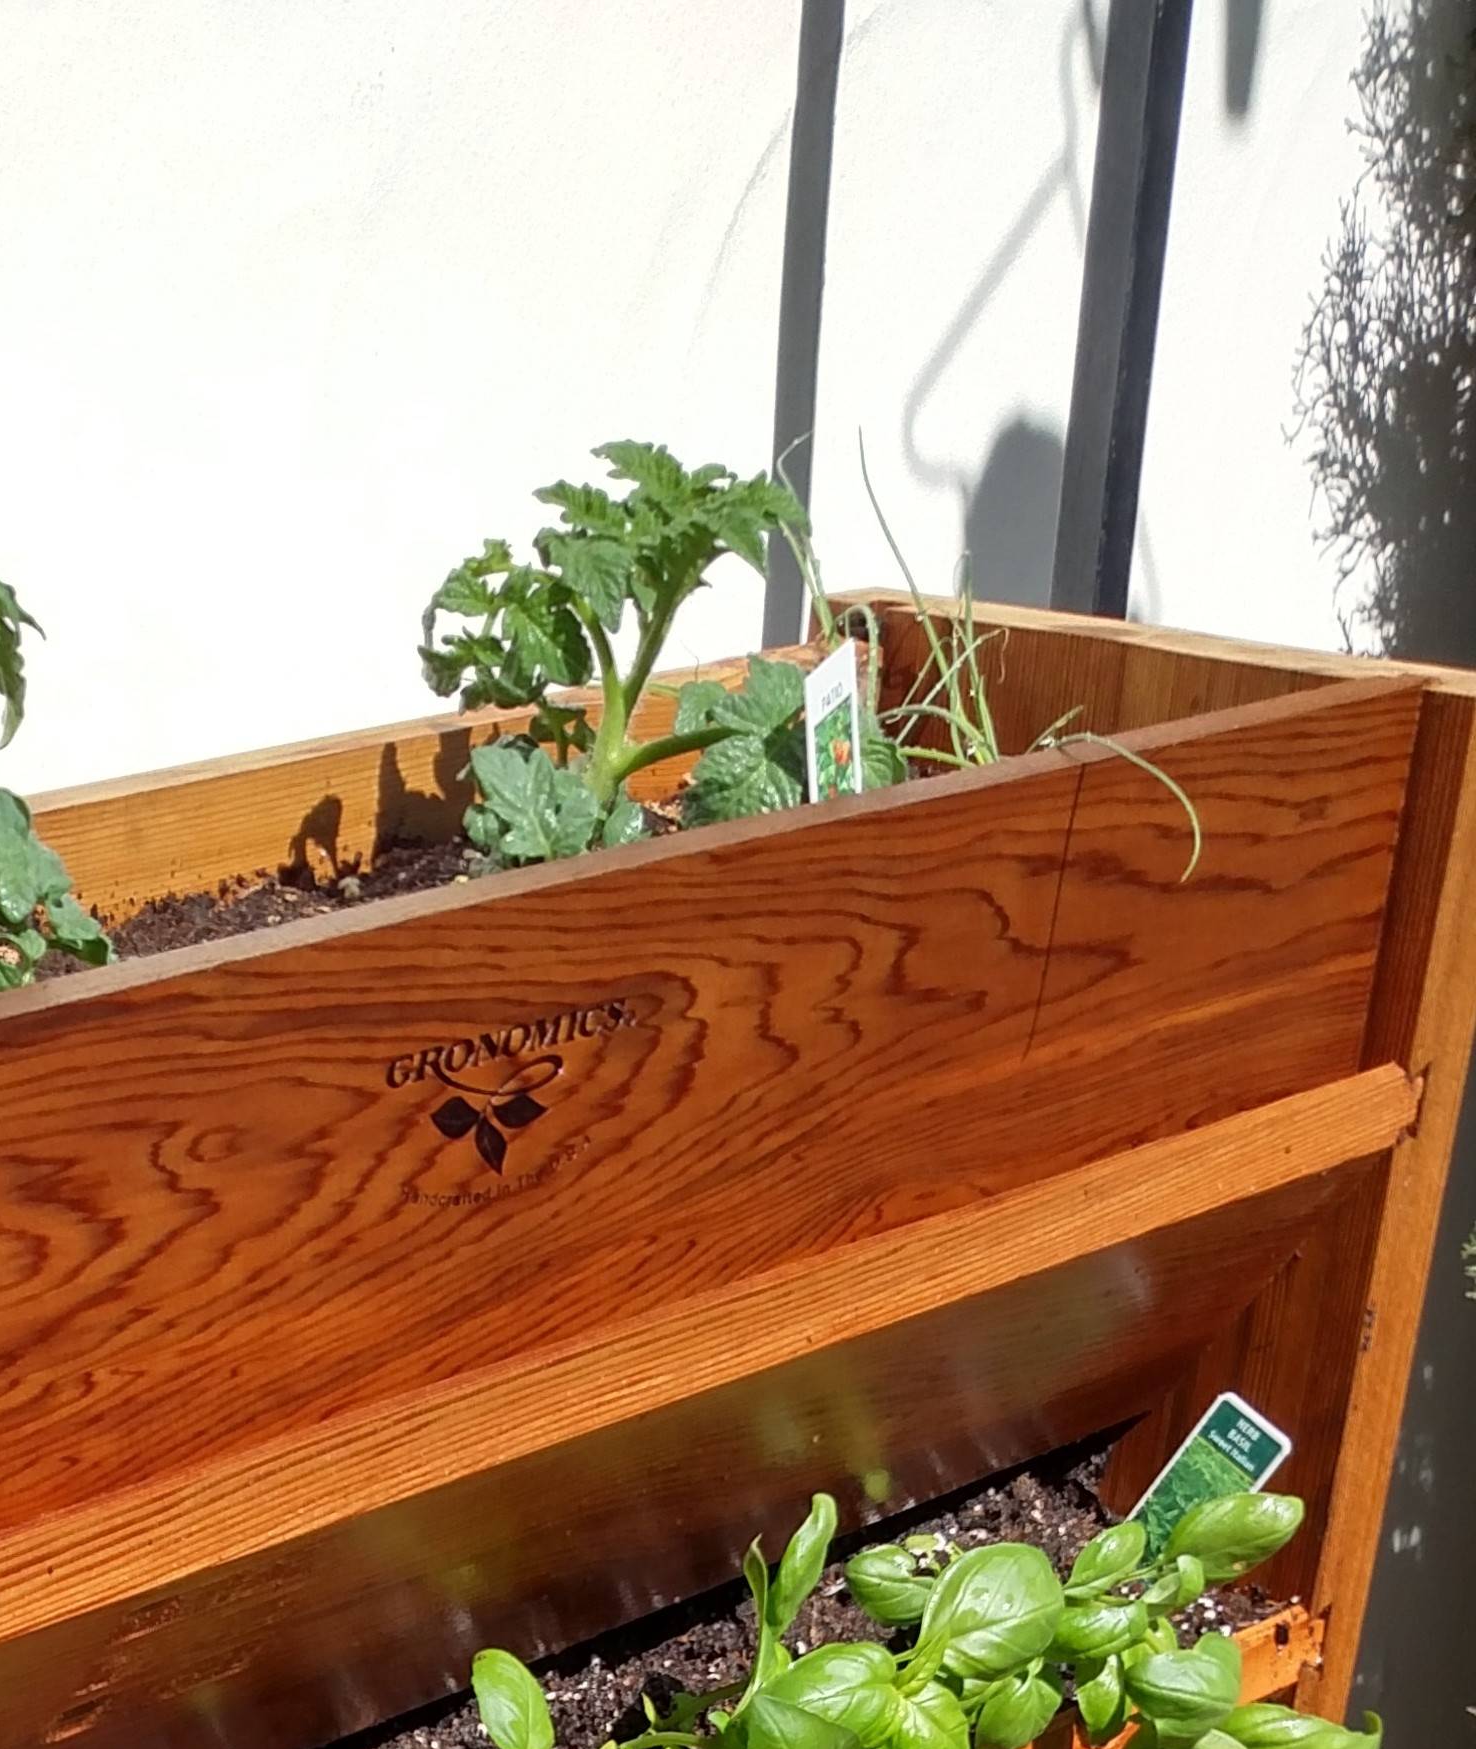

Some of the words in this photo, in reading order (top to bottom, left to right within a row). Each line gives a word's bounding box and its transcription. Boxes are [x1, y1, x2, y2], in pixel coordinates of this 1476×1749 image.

[385, 998, 628, 1089] GRONOMICS
[1226, 1428, 1252, 1453] BASIL
[1235, 1418, 1261, 1442] HERB
